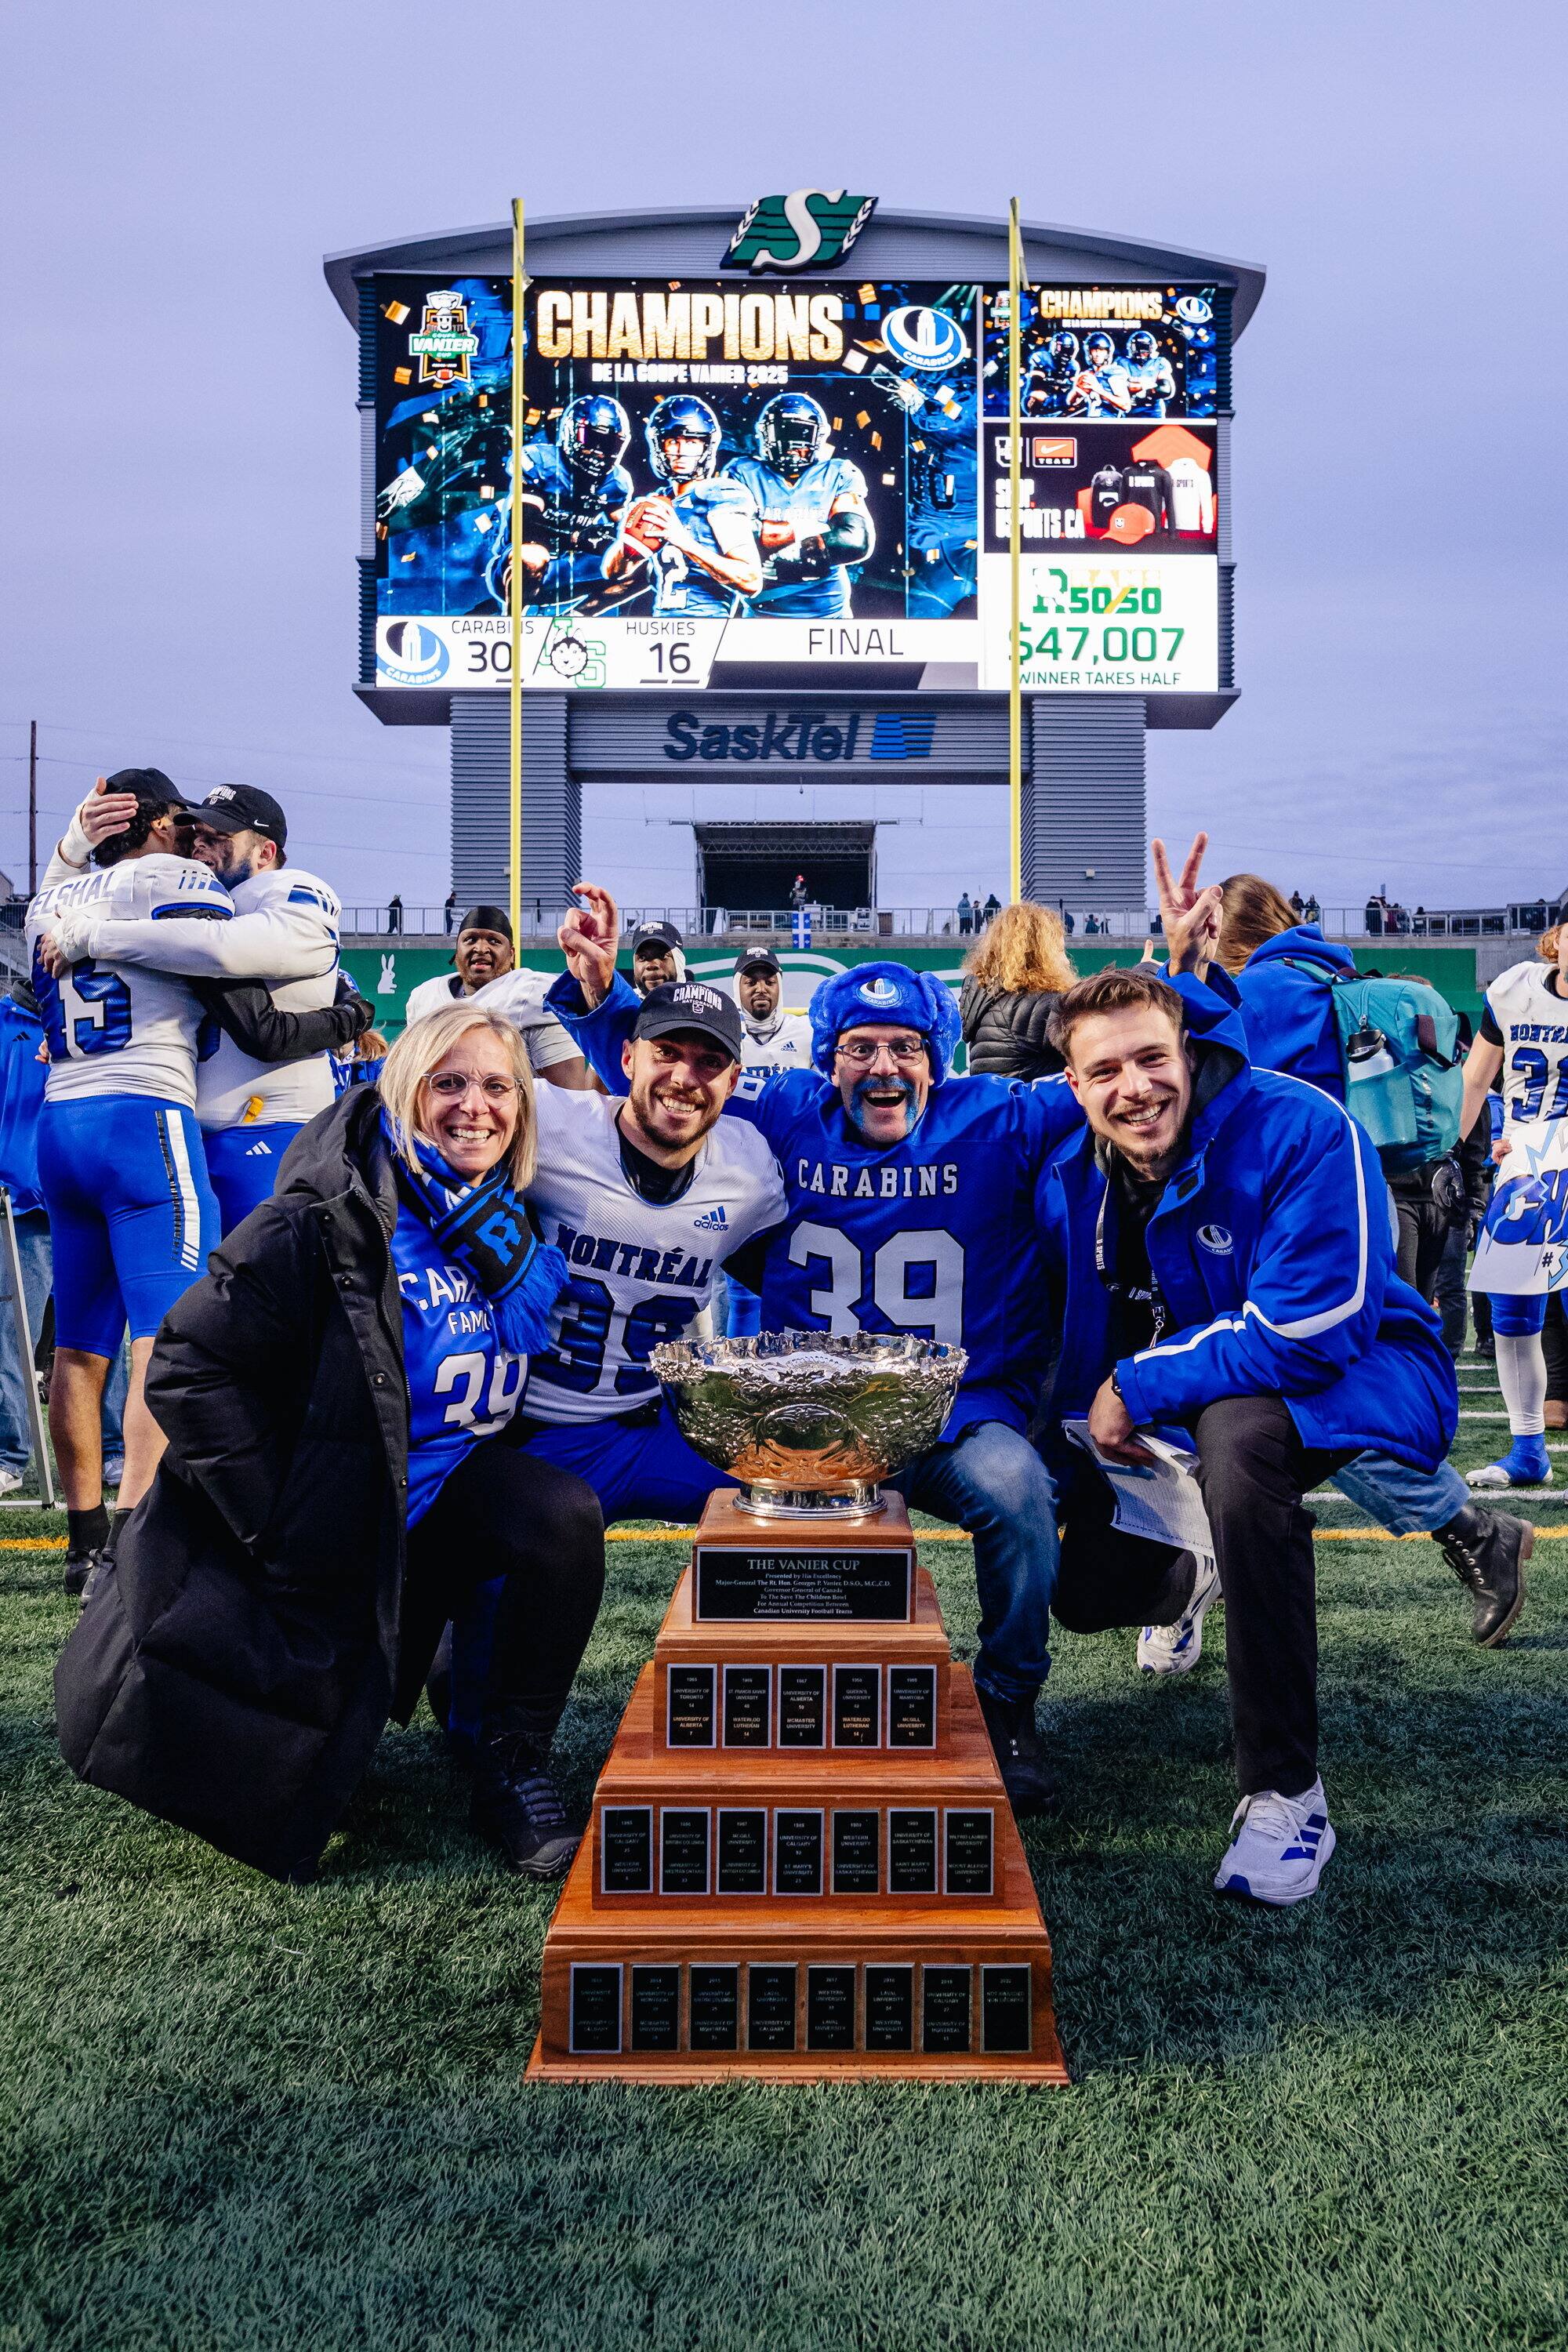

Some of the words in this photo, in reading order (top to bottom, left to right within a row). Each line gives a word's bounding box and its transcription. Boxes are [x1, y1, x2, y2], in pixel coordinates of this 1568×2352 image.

[1040, 291, 1163, 320] CHAMPIONS
[537, 290, 843, 361] CHAMPIONS
[413, 338, 475, 352] VANIER
[592, 363, 613, 382] DE
[615, 364, 634, 382] LA
[636, 364, 688, 383] COUPE
[690, 365, 745, 383] VANIER
[747, 365, 789, 384] 2025
[452, 620, 534, 634] CARABIS
[626, 621, 696, 635] HUSKIES
[808, 629, 905, 655] FINAL
[468, 641, 512, 673] 30
[648, 642, 691, 674] 16
[1018, 672, 1080, 684] WINNER
[1085, 673, 1135, 684] TAKES
[1141, 673, 1182, 684] HALF
[663, 710, 860, 760] SaskTel
[673, 987, 722, 1011] CHAMPIONS
[1510, 1024, 1568, 1044] MONTR
[798, 1159, 958, 1197] CARABINS
[693, 1218, 729, 1232] adidas
[784, 1220, 965, 1350] 39
[434, 1352, 528, 1437] 39
[747, 1559, 775, 1570] THE
[779, 1559, 829, 1570] VANIER
[833, 1559, 860, 1570] CUP
